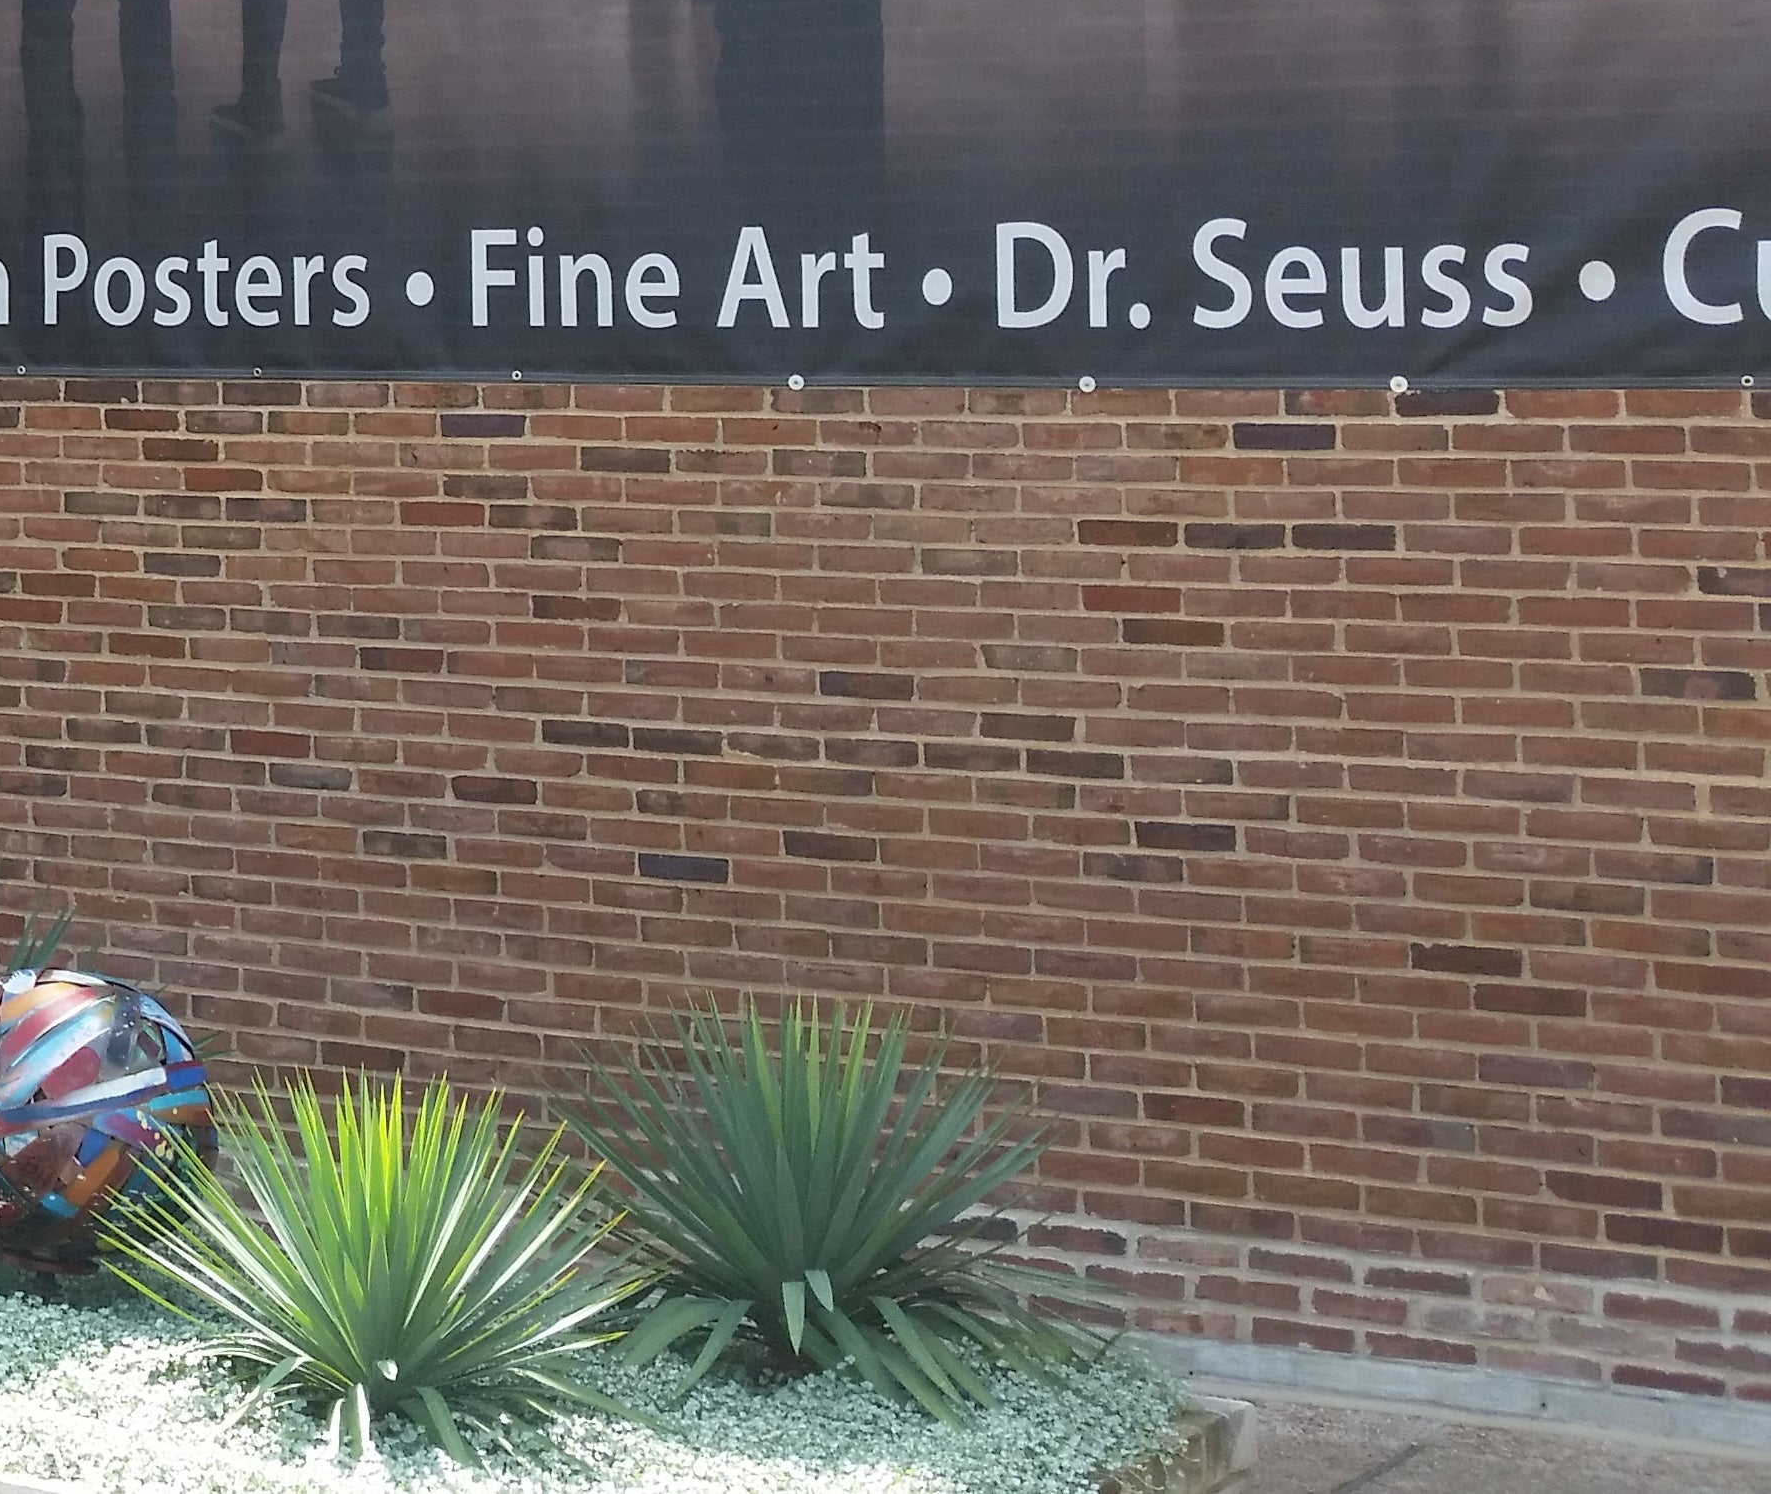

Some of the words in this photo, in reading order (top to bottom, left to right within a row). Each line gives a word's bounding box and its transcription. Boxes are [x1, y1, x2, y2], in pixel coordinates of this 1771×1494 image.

[43, 232, 372, 329] Posters
[470, 226, 682, 329] Fine
[716, 225, 887, 330] Art
[995, 221, 1152, 330] Dr.
[1192, 217, 1534, 330] Seuss
